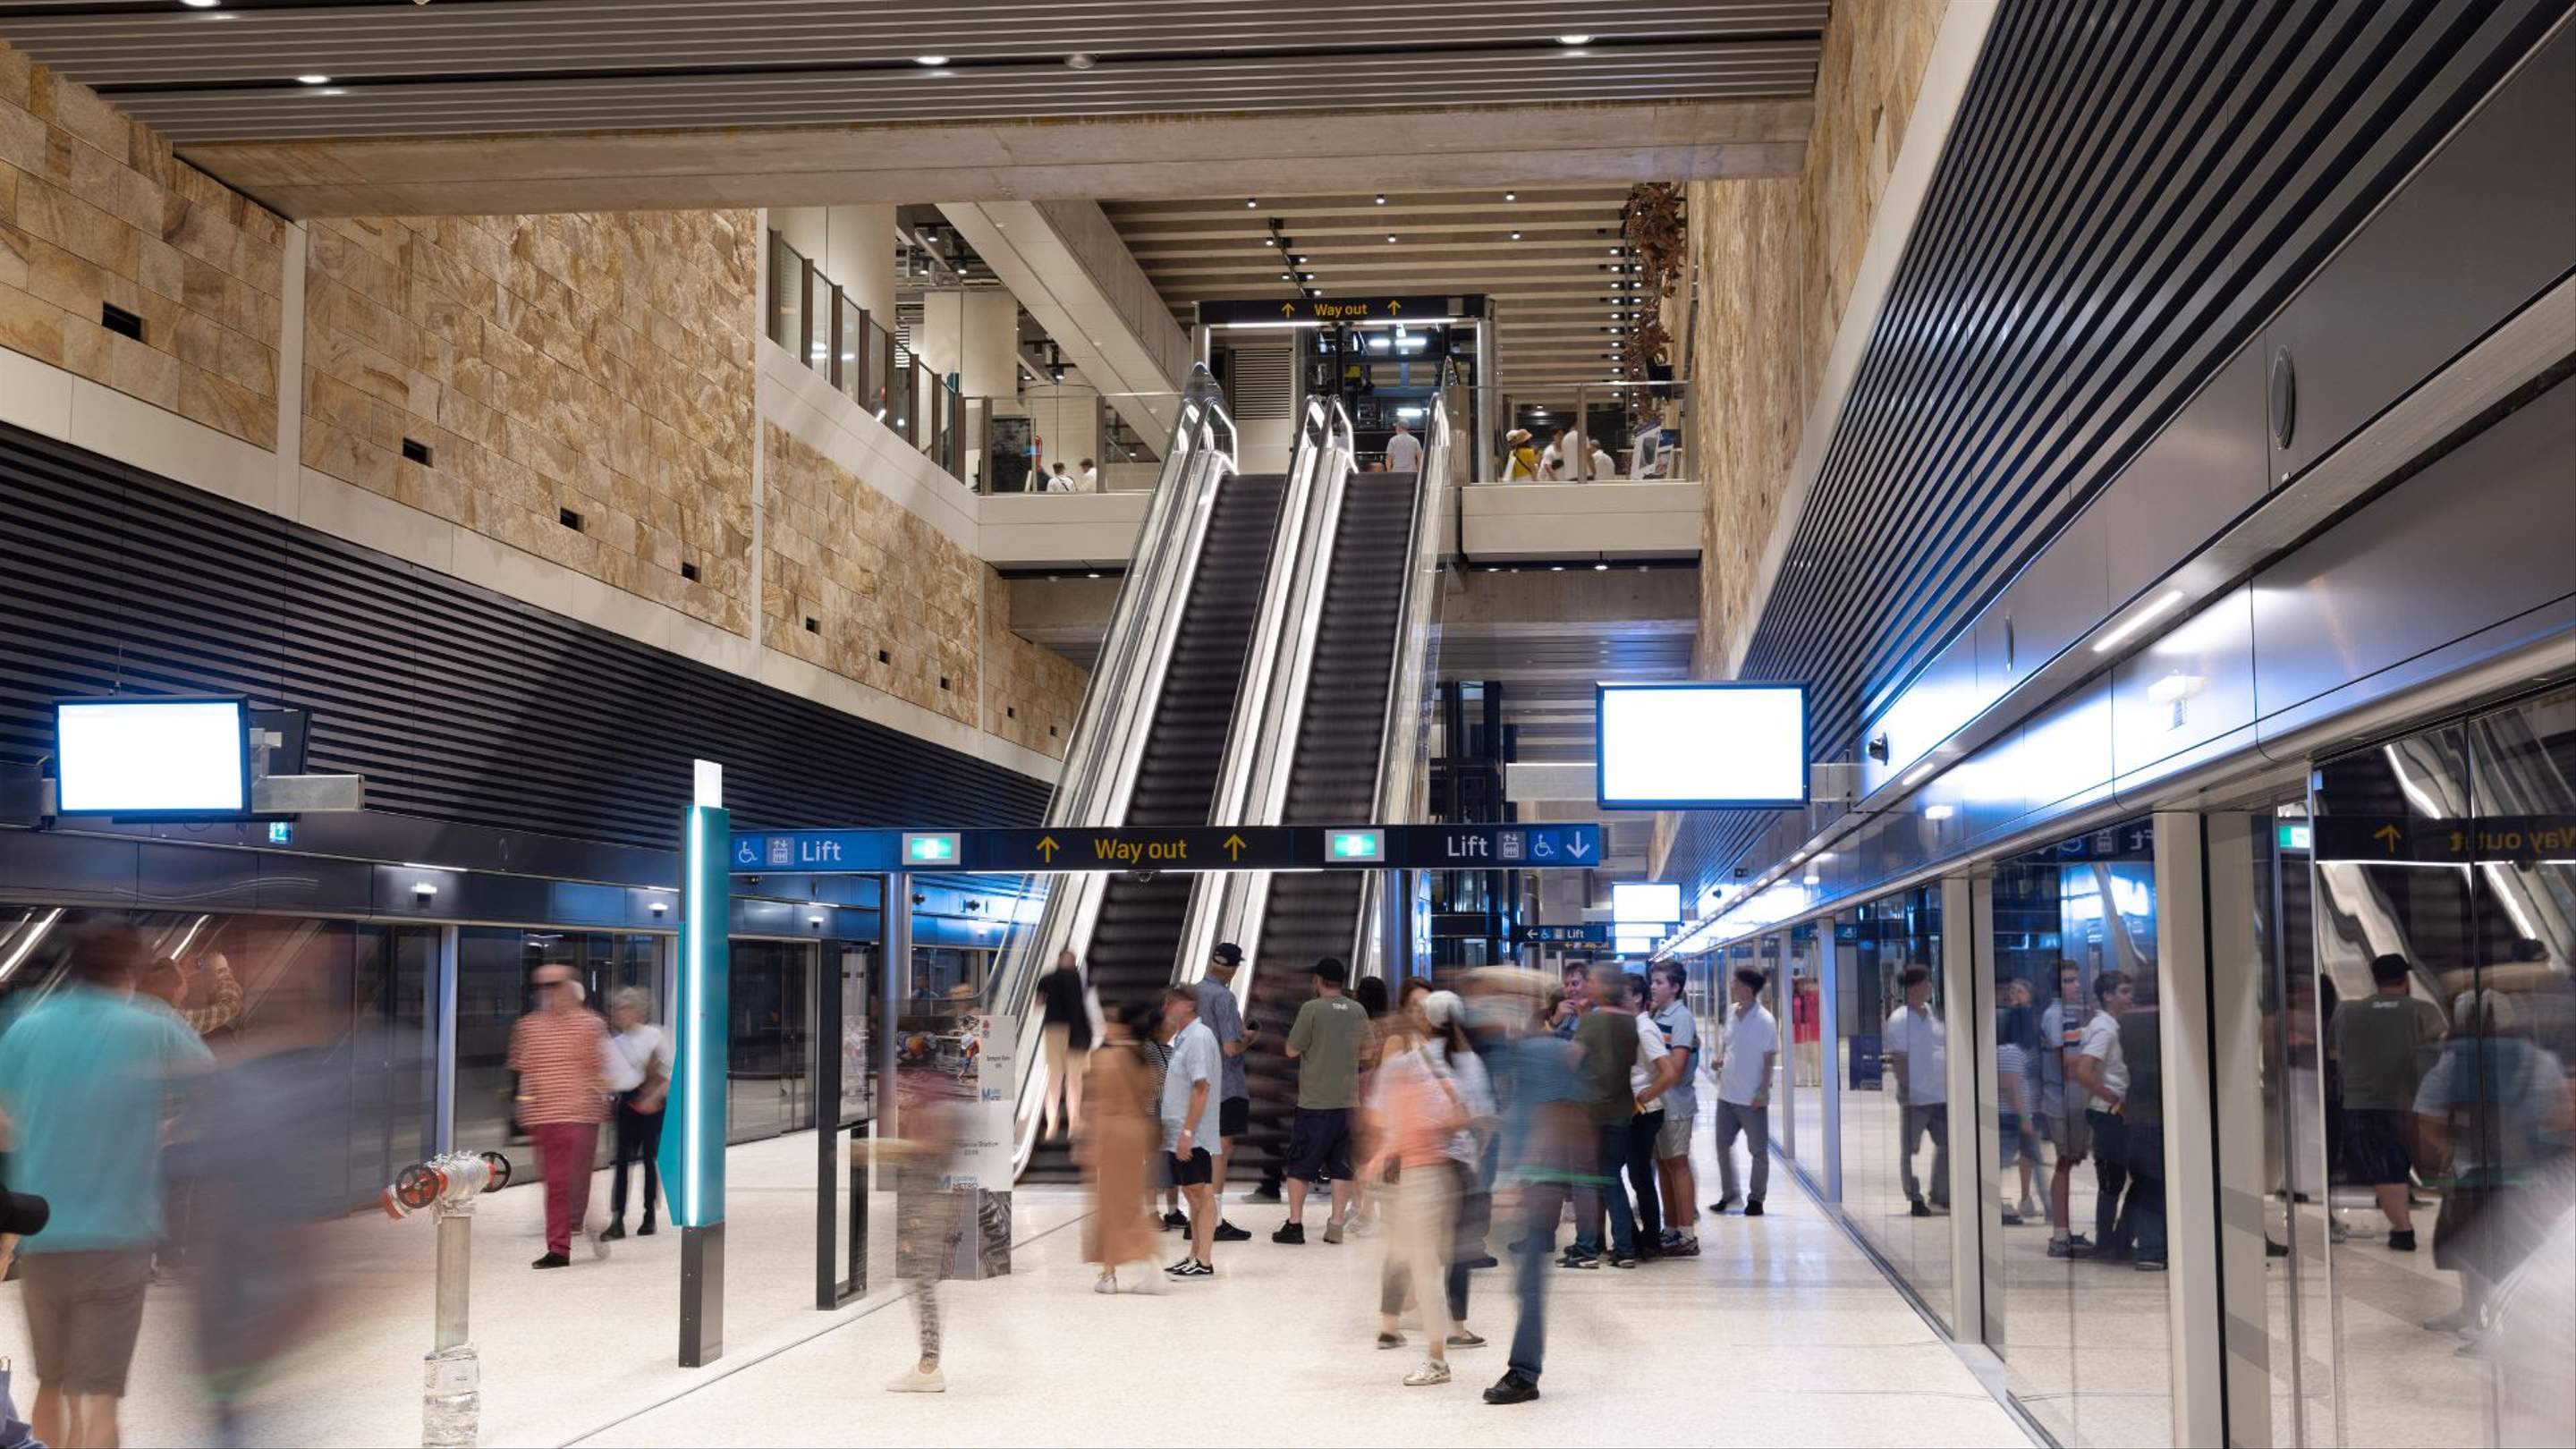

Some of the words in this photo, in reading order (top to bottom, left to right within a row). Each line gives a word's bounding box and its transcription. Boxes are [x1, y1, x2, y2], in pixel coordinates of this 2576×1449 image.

[1314, 303, 1342, 318] Way
[1344, 303, 1368, 315] out
[801, 840, 842, 861] Lift
[1094, 838, 1142, 864] Way
[1148, 839, 1187, 859] out
[1447, 835, 1488, 857] Lift
[1566, 928, 1585, 939] Lift
